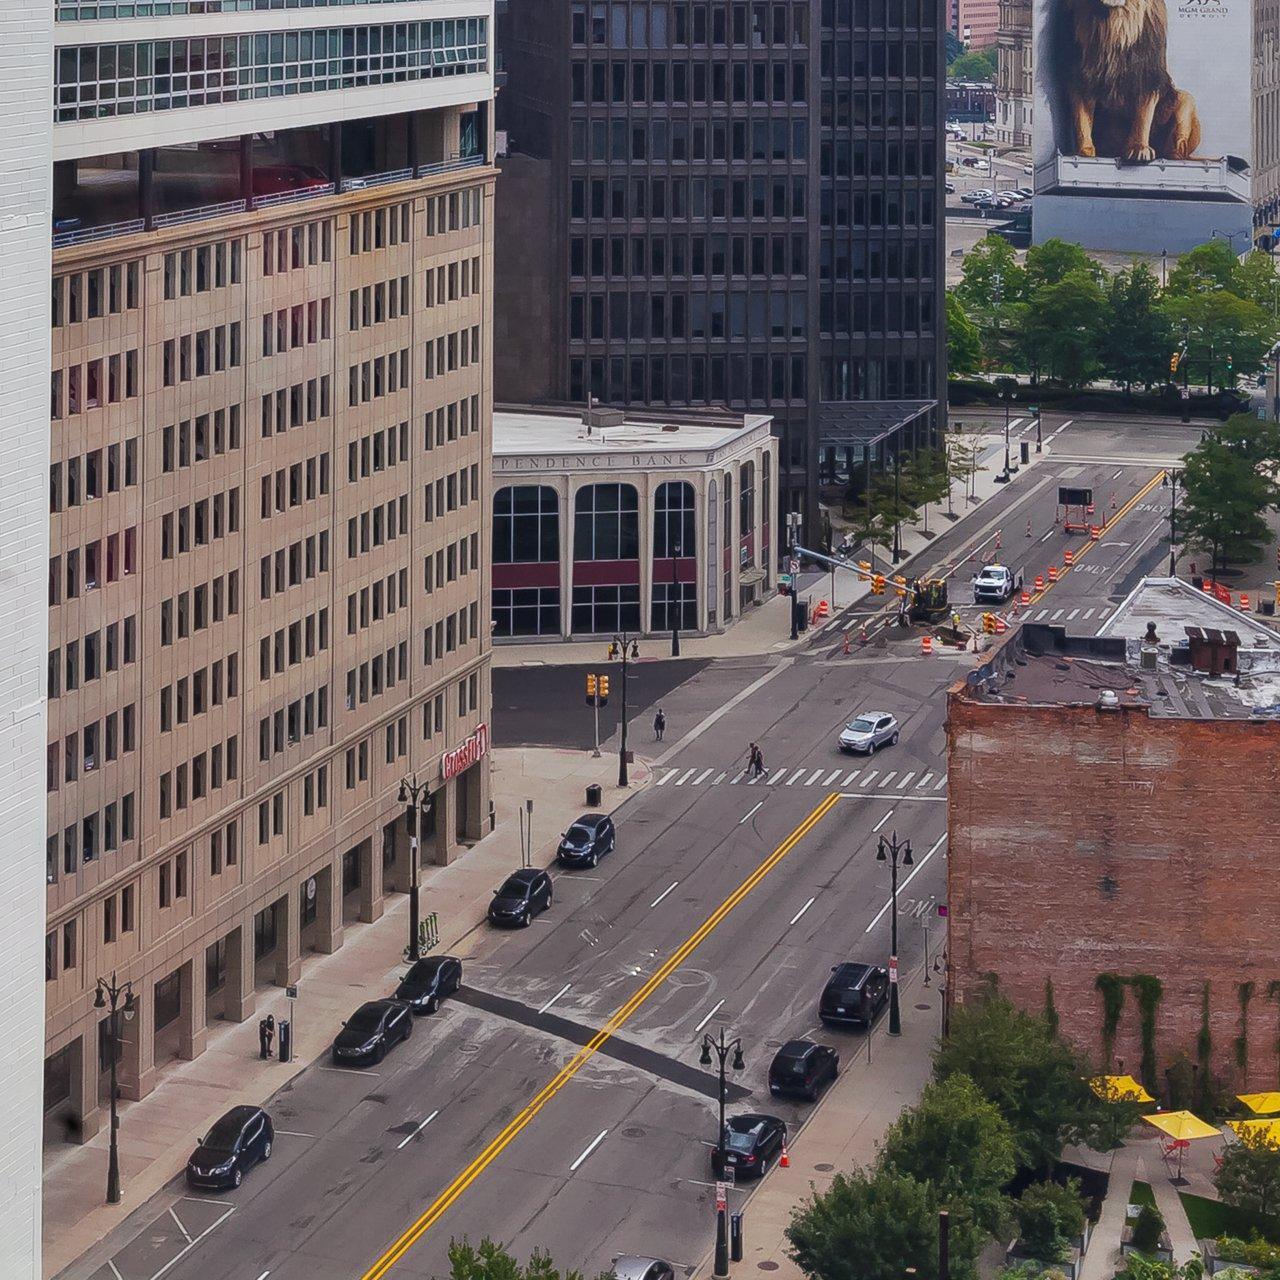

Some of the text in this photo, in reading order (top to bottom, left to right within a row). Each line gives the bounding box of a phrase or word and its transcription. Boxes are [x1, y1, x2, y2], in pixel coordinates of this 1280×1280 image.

[632, 453, 688, 466] BANK
[1135, 504, 1167, 512] ONLY
[1074, 564, 1110, 574] ONLY
